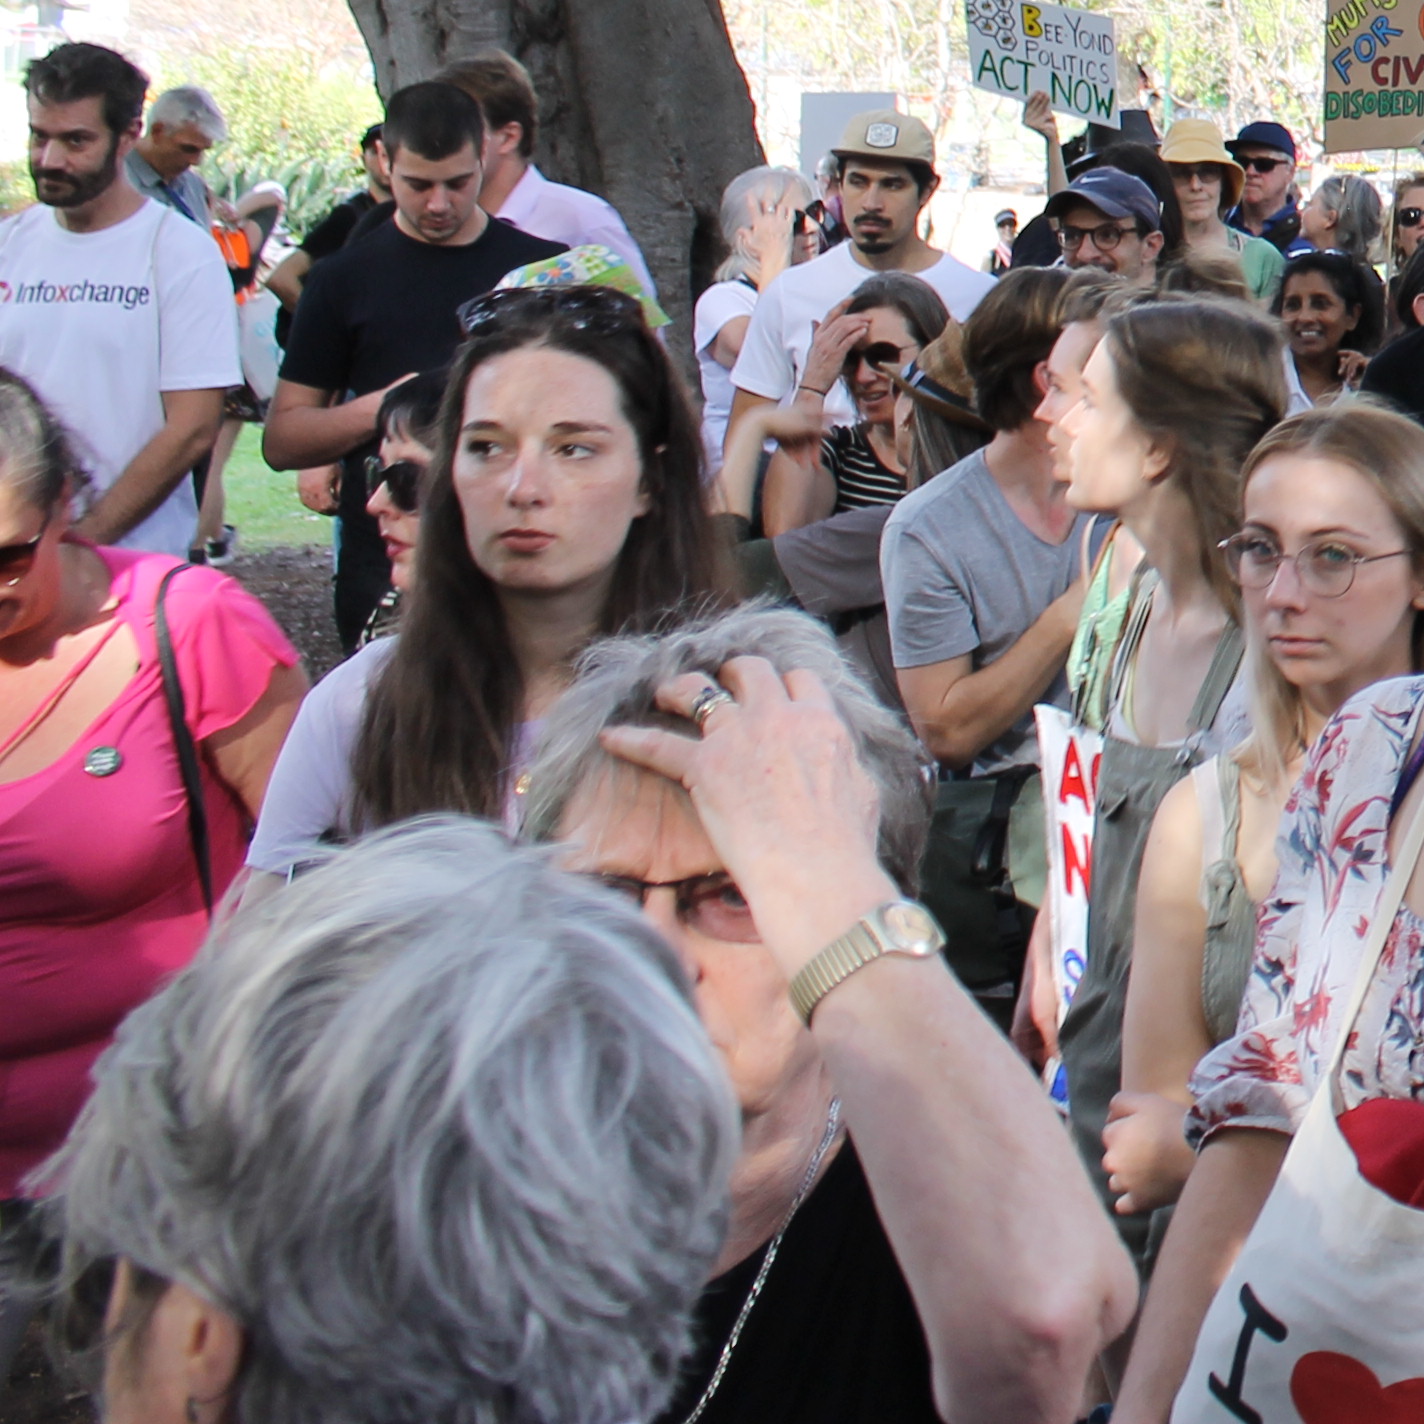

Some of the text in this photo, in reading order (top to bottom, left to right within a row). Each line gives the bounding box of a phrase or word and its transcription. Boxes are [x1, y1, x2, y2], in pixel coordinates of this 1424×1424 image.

[977, 49, 1115, 120] ACT NOW
[1025, 40, 1110, 84] POLITICS
[1332, 16, 1403, 85] FOR
